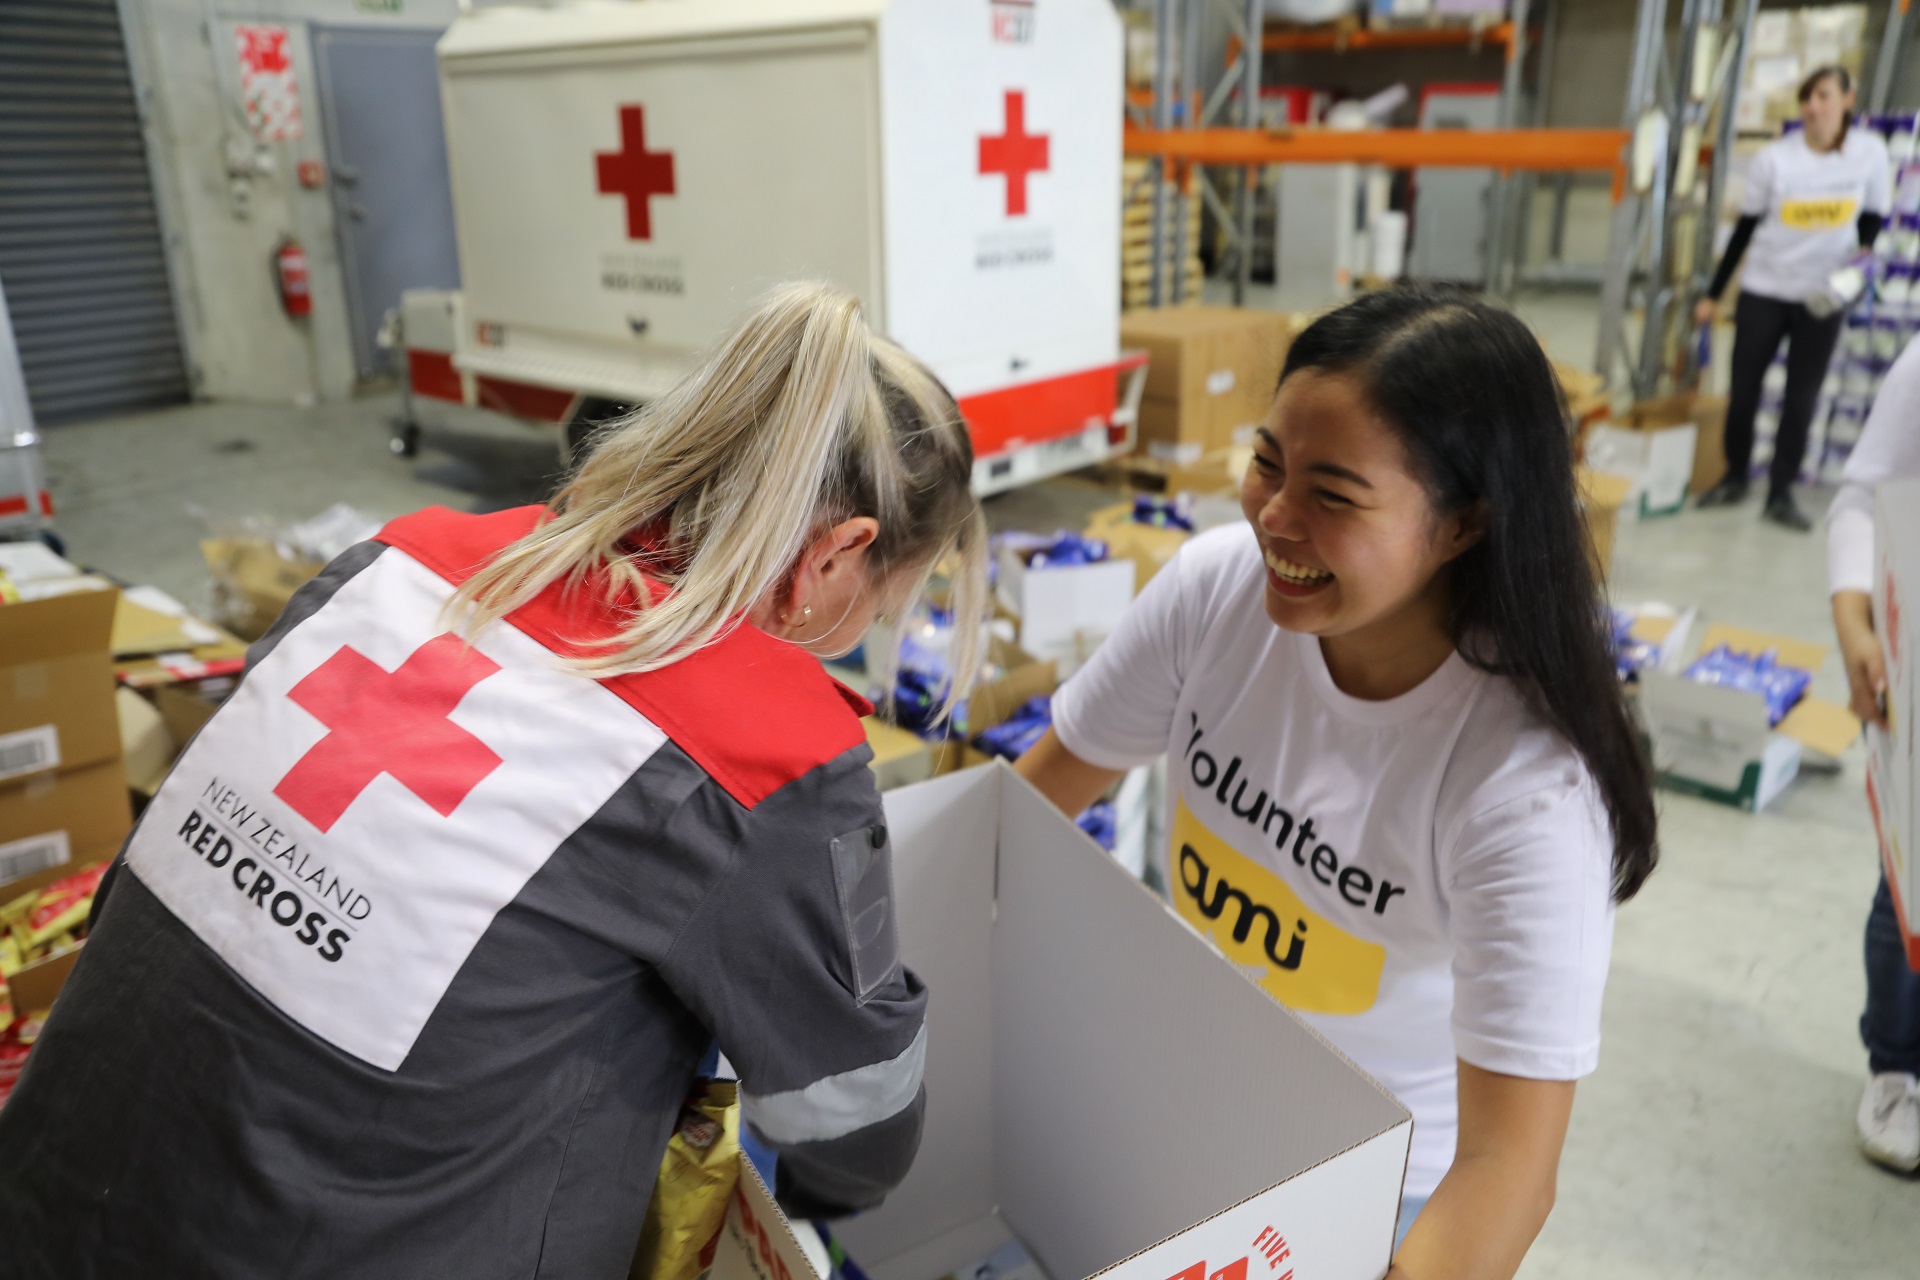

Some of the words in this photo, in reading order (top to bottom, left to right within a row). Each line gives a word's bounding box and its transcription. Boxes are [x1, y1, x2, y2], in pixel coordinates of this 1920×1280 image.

[177, 809, 233, 869] RED
[232, 857, 351, 963] CROSS
[202, 776, 257, 829] NEW
[249, 817, 372, 921] ZEALAND
[1179, 842, 1308, 972] ami
[1251, 1224, 1291, 1270] FIVE
